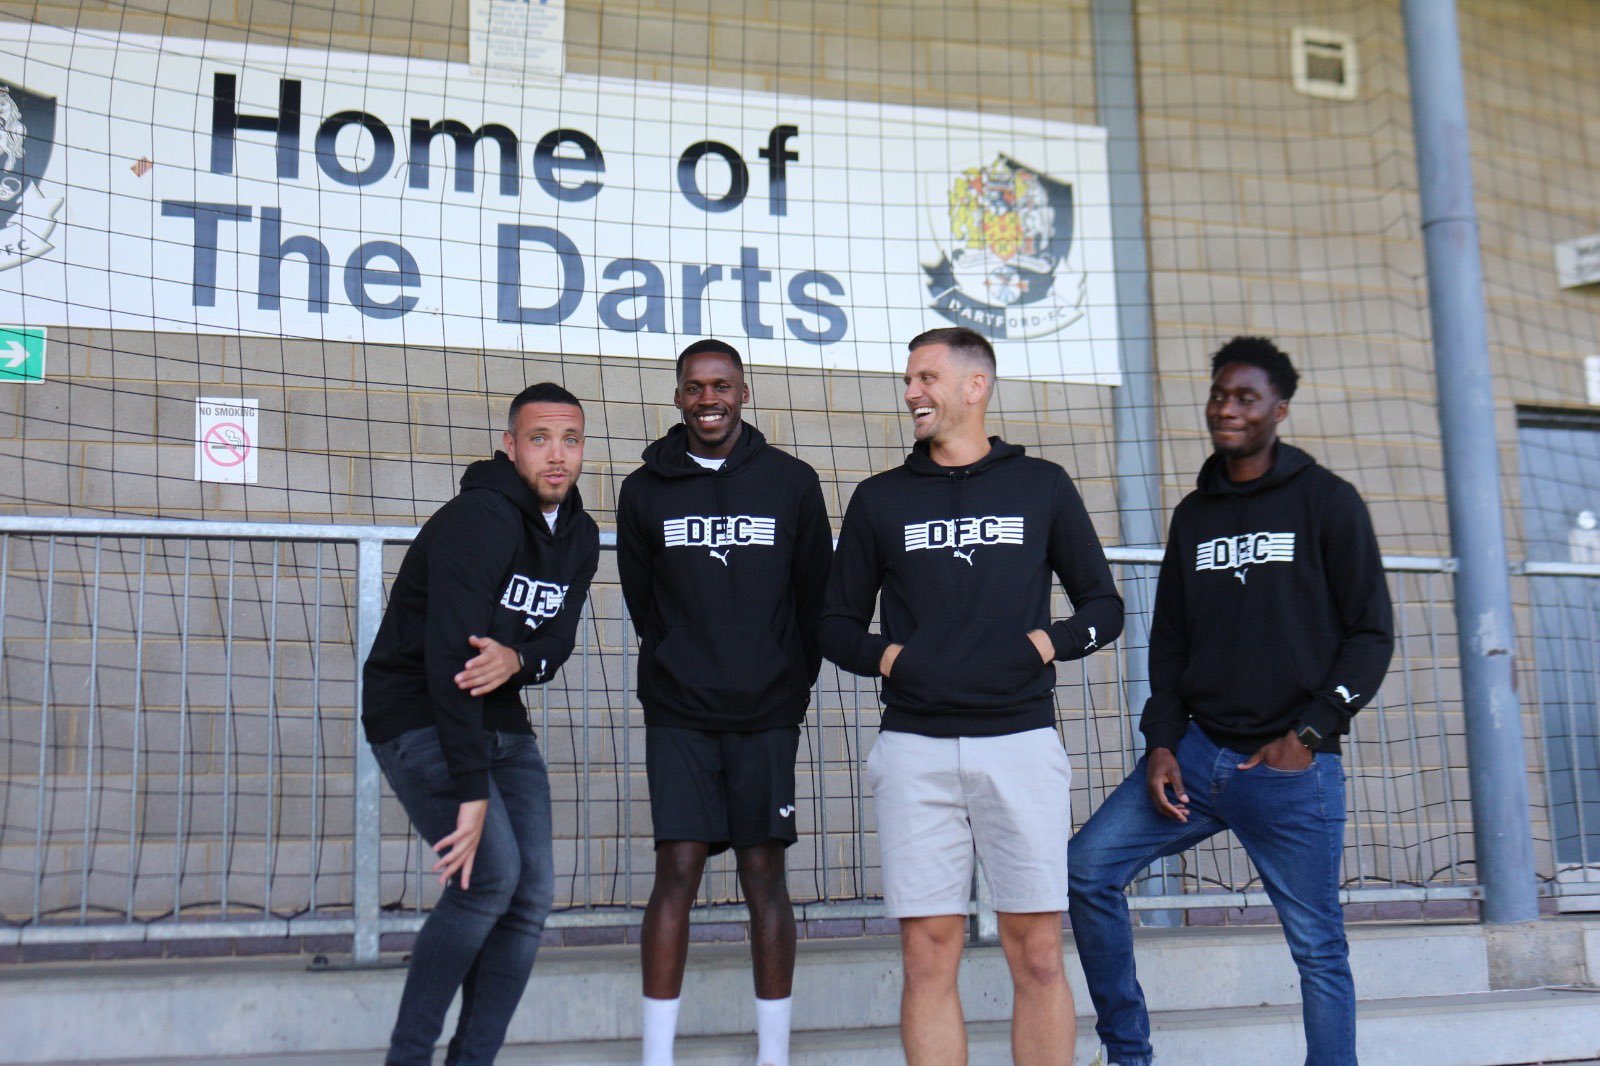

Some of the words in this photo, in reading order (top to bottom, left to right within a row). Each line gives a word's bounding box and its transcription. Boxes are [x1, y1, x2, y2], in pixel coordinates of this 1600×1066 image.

[210, 72, 606, 202] Home
[677, 125, 799, 216] of
[161, 200, 422, 319] The
[497, 223, 848, 345] Darts
[199, 406, 212, 416] NO
[214, 407, 255, 417] SMOKING
[685, 516, 753, 547] DFC
[926, 517, 1000, 547] DFC
[1212, 533, 1270, 568] DFC
